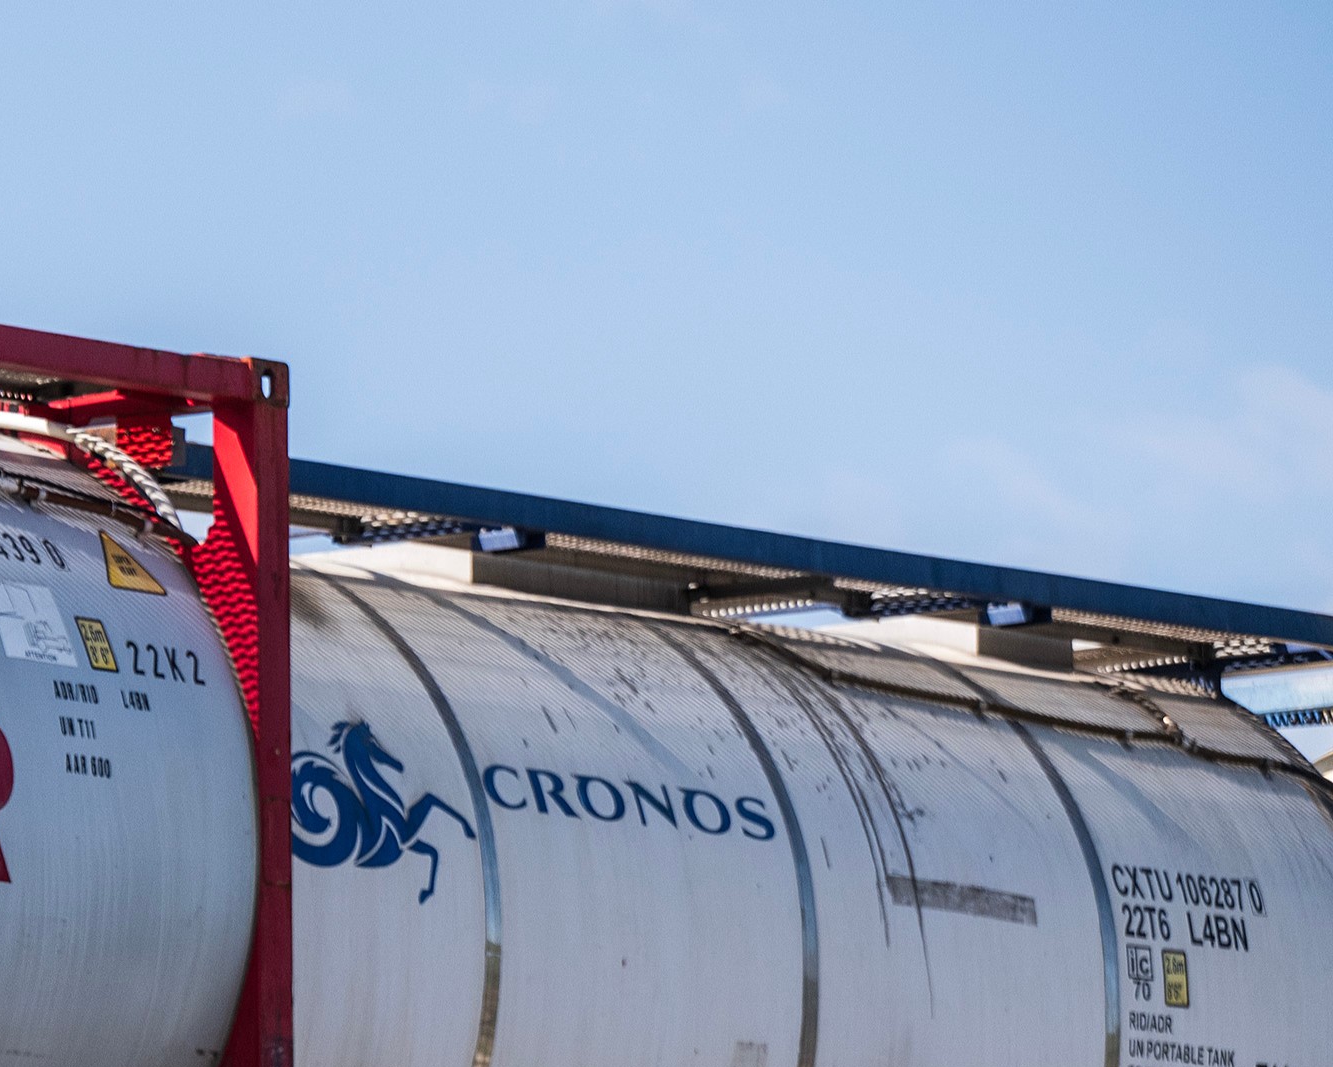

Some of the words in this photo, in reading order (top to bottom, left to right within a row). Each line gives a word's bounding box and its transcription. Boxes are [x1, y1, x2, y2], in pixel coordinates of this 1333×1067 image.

[126, 641, 206, 687] 22K2
[53, 680, 98, 704] ADR/RID
[59, 716, 75, 736] UN
[66, 753, 87, 775] AAR
[482, 763, 777, 843] CRONOS
[1111, 863, 1173, 902] CXTU
[1176, 872, 1243, 911] 106287
[1122, 903, 1171, 941] 22T6
[1186, 911, 1248, 952] L4BN
[1129, 1012, 1172, 1034] RID/ADR
[1129, 1040, 1143, 1058] UN
[1146, 1040, 1204, 1065] PORTABLE
